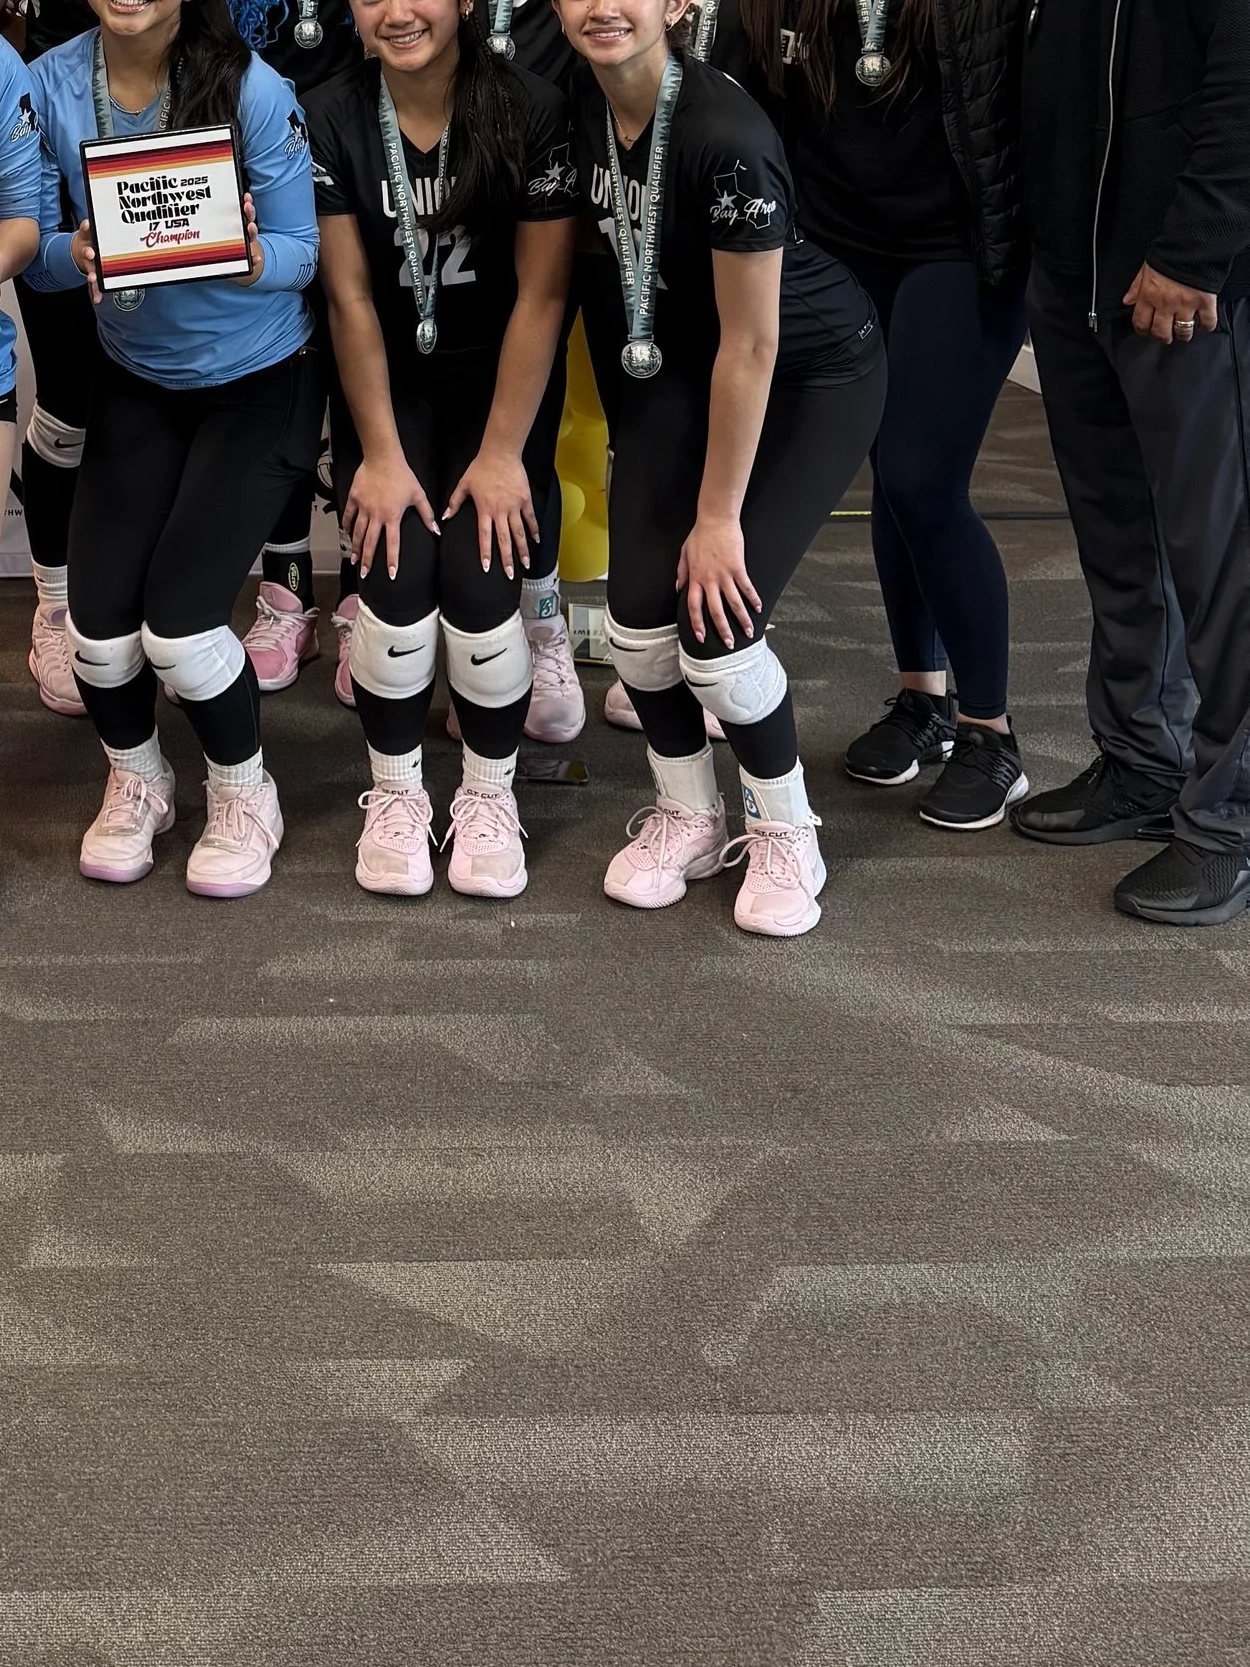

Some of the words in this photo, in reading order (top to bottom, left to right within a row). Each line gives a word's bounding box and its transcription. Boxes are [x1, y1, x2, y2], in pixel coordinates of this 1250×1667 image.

[116, 175, 179, 196] Pacific
[180, 175, 209, 187] 2025
[609, 158, 628, 229] NORTHWEST
[651, 145, 664, 203] QUALIFIER
[118, 185, 212, 210] Northwest
[121, 202, 200, 224] Qualifier
[388, 142, 403, 182] PACIFIC
[396, 185, 414, 250] NORTHWEST
[710, 204, 740, 227] Bay
[139, 229, 201, 248] Champion
[148, 222, 161, 232] 17
[164, 218, 190, 230] USA
[643, 203, 658, 274] NORTHWEST
[393, 224, 477, 288] 22
[618, 229, 636, 286] QUALIFIER
[639, 274, 653, 316] PACIFIC
